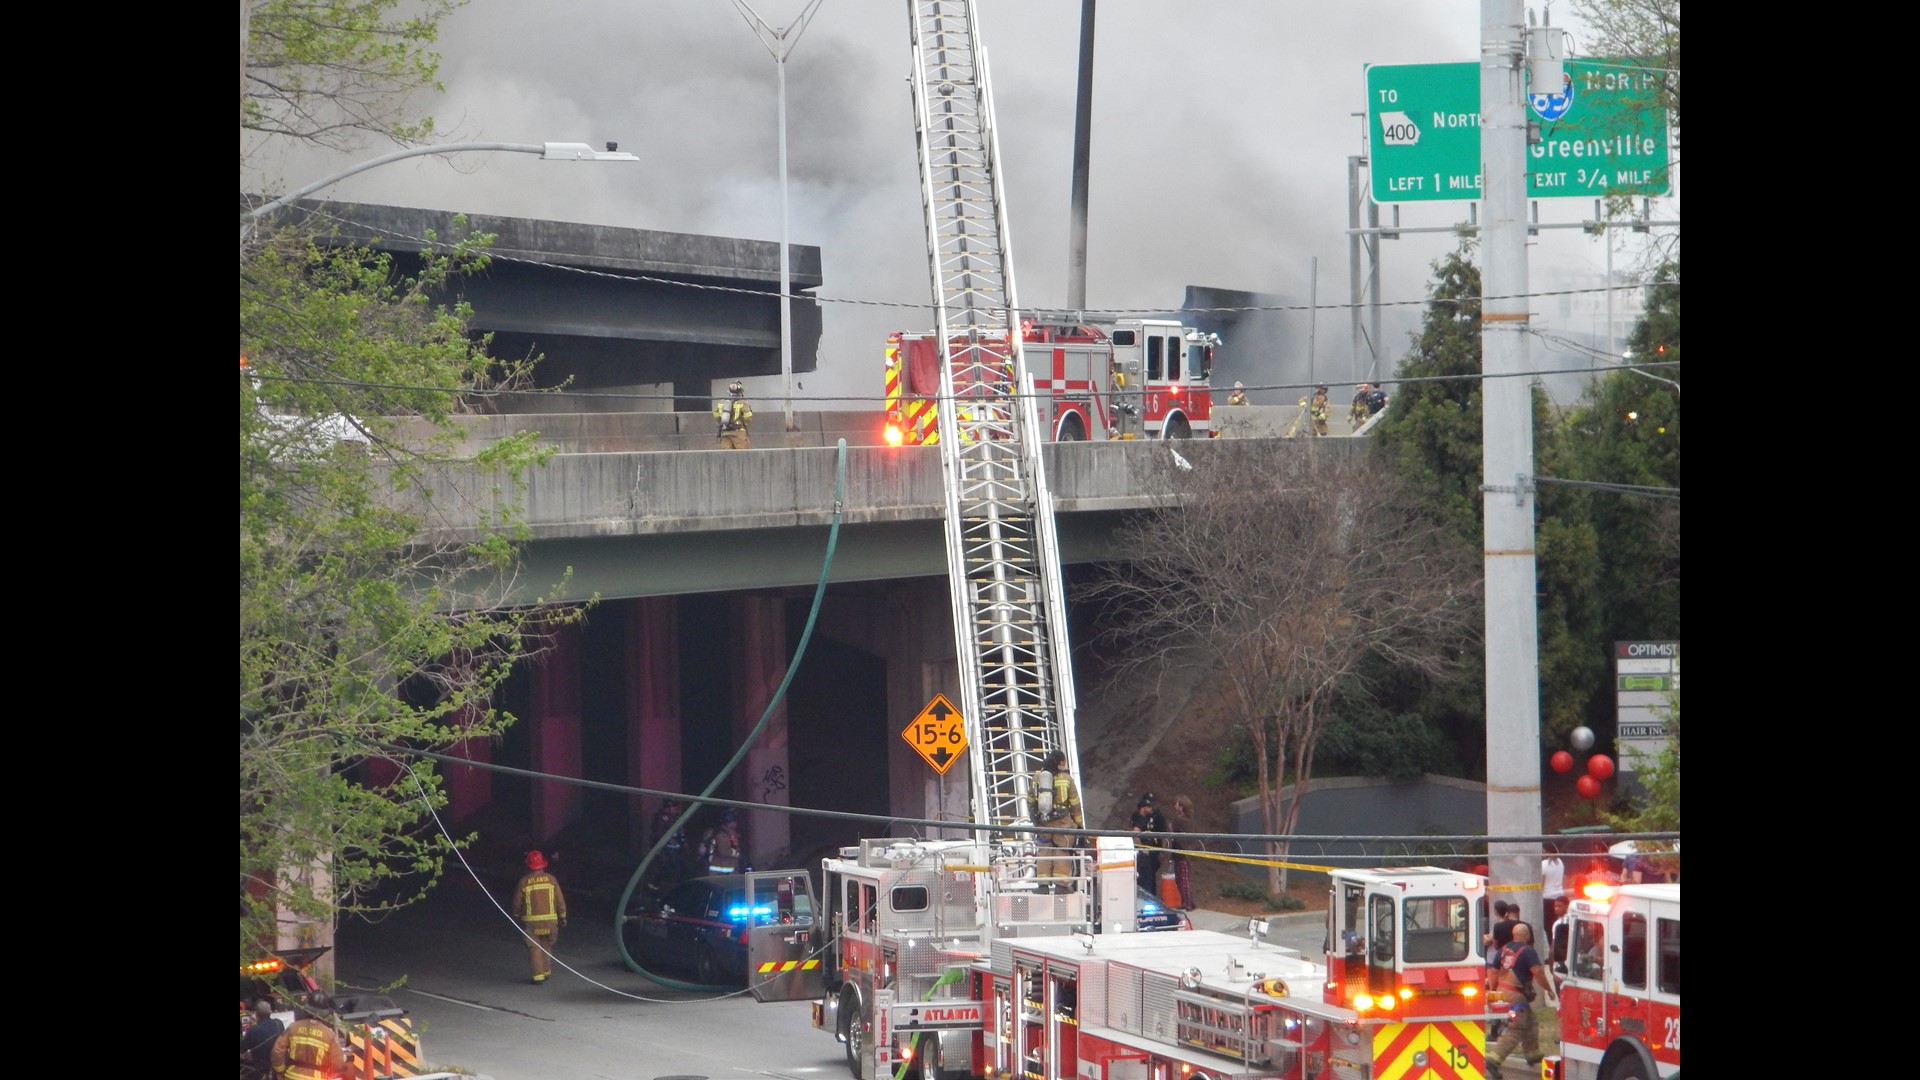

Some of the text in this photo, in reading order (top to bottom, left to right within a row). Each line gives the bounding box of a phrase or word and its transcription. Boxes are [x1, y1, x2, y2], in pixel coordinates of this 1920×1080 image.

[1586, 70, 1655, 90] NORTH
[1379, 89, 1398, 103] TO
[1385, 124, 1416, 141] 400
[1530, 134, 1655, 158] Greenville
[1389, 172, 1481, 192] LEFT 1 MILE
[1536, 168, 1652, 188] EXIT 3/4 MILE
[1152, 393, 1159, 413] 6
[1628, 644, 1677, 656] OPTIMIST
[1623, 727, 1647, 736] HAIR
[924, 1008, 979, 1021] ATLANTA
[1664, 1016, 1680, 1050] 23
[1446, 1044, 1469, 1069] 15
